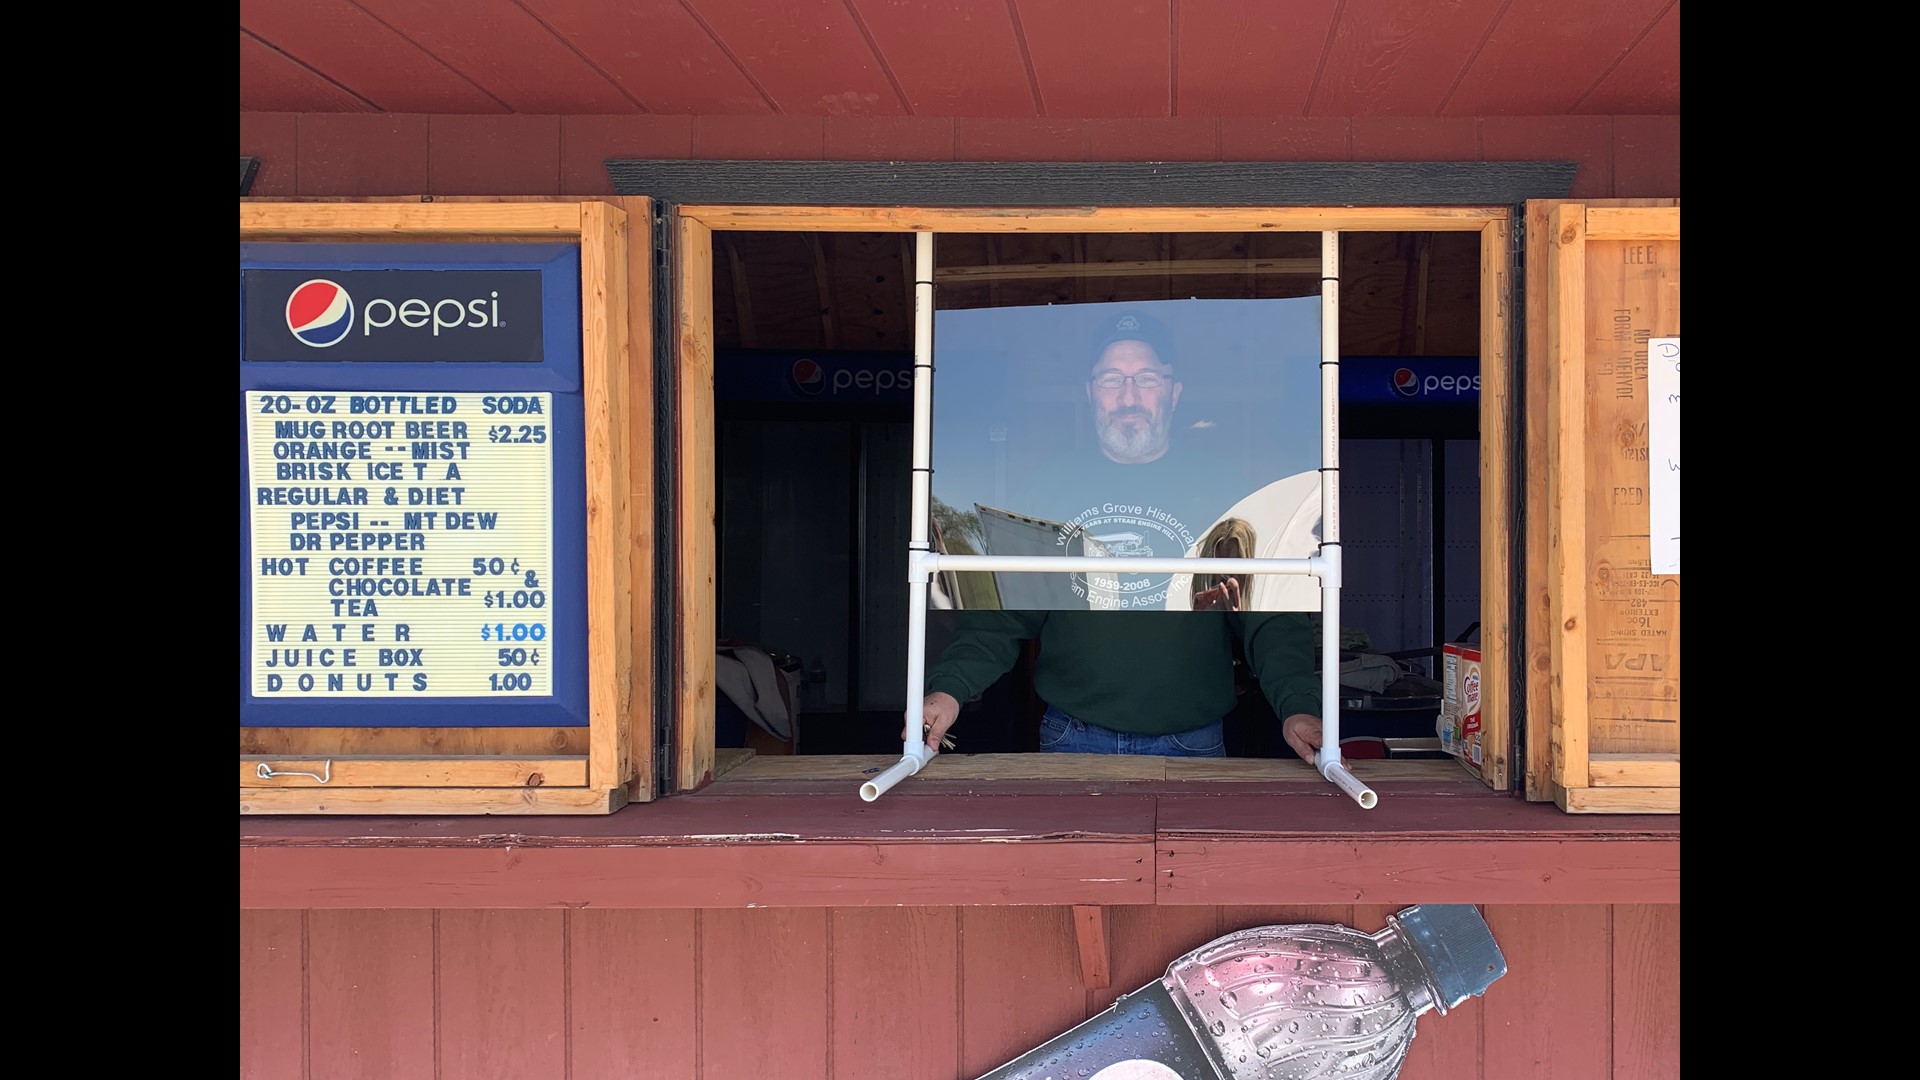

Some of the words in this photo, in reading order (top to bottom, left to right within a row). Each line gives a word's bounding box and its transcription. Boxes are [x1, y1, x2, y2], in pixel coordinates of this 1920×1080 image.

[364, 290, 499, 336] pepsi
[833, 369, 912, 395] peps
[1424, 375, 1482, 395] peps
[349, 395, 457, 415] BOTTLED
[481, 395, 542, 415] SODA
[274, 420, 326, 440] MUG
[331, 420, 394, 440] ROOT
[405, 421, 468, 440] BEER
[489, 424, 547, 444] $2.25
[273, 441, 370, 460] ORANGE
[411, 441, 469, 461] MIST
[276, 461, 351, 481] BRISK
[367, 462, 403, 481] ICE
[257, 487, 368, 506] REGULAR
[383, 486, 399, 506] &
[407, 487, 465, 506] DIET
[290, 511, 359, 531] PEPSI
[403, 511, 437, 531] MT
[445, 511, 497, 530] DEW
[1056, 505, 1099, 546] Williams
[1102, 502, 1142, 515] Grove
[1113, 517, 1137, 525] STEAM
[1137, 519, 1161, 532] ENGINE
[1161, 527, 1175, 541] HILL
[289, 532, 321, 551] DR
[329, 532, 425, 551] PEPPER
[261, 557, 309, 577] HOT
[328, 557, 421, 577] COFFEE
[328, 577, 470, 597] CHOCOLATE
[524, 570, 539, 589] &
[1094, 577, 1151, 591] 1959-2008
[1086, 590, 1129, 609] Engine
[1131, 590, 1172, 608] Assoc.
[1171, 575, 1191, 593] Inc.
[331, 598, 378, 617] TEA
[485, 589, 546, 609] $1.00
[266, 623, 410, 642] WATER
[480, 623, 547, 642] $1.00
[266, 648, 356, 667] JUICE
[378, 648, 422, 667] BOX
[267, 672, 427, 692] DONUTS
[489, 672, 532, 691] 1.00
